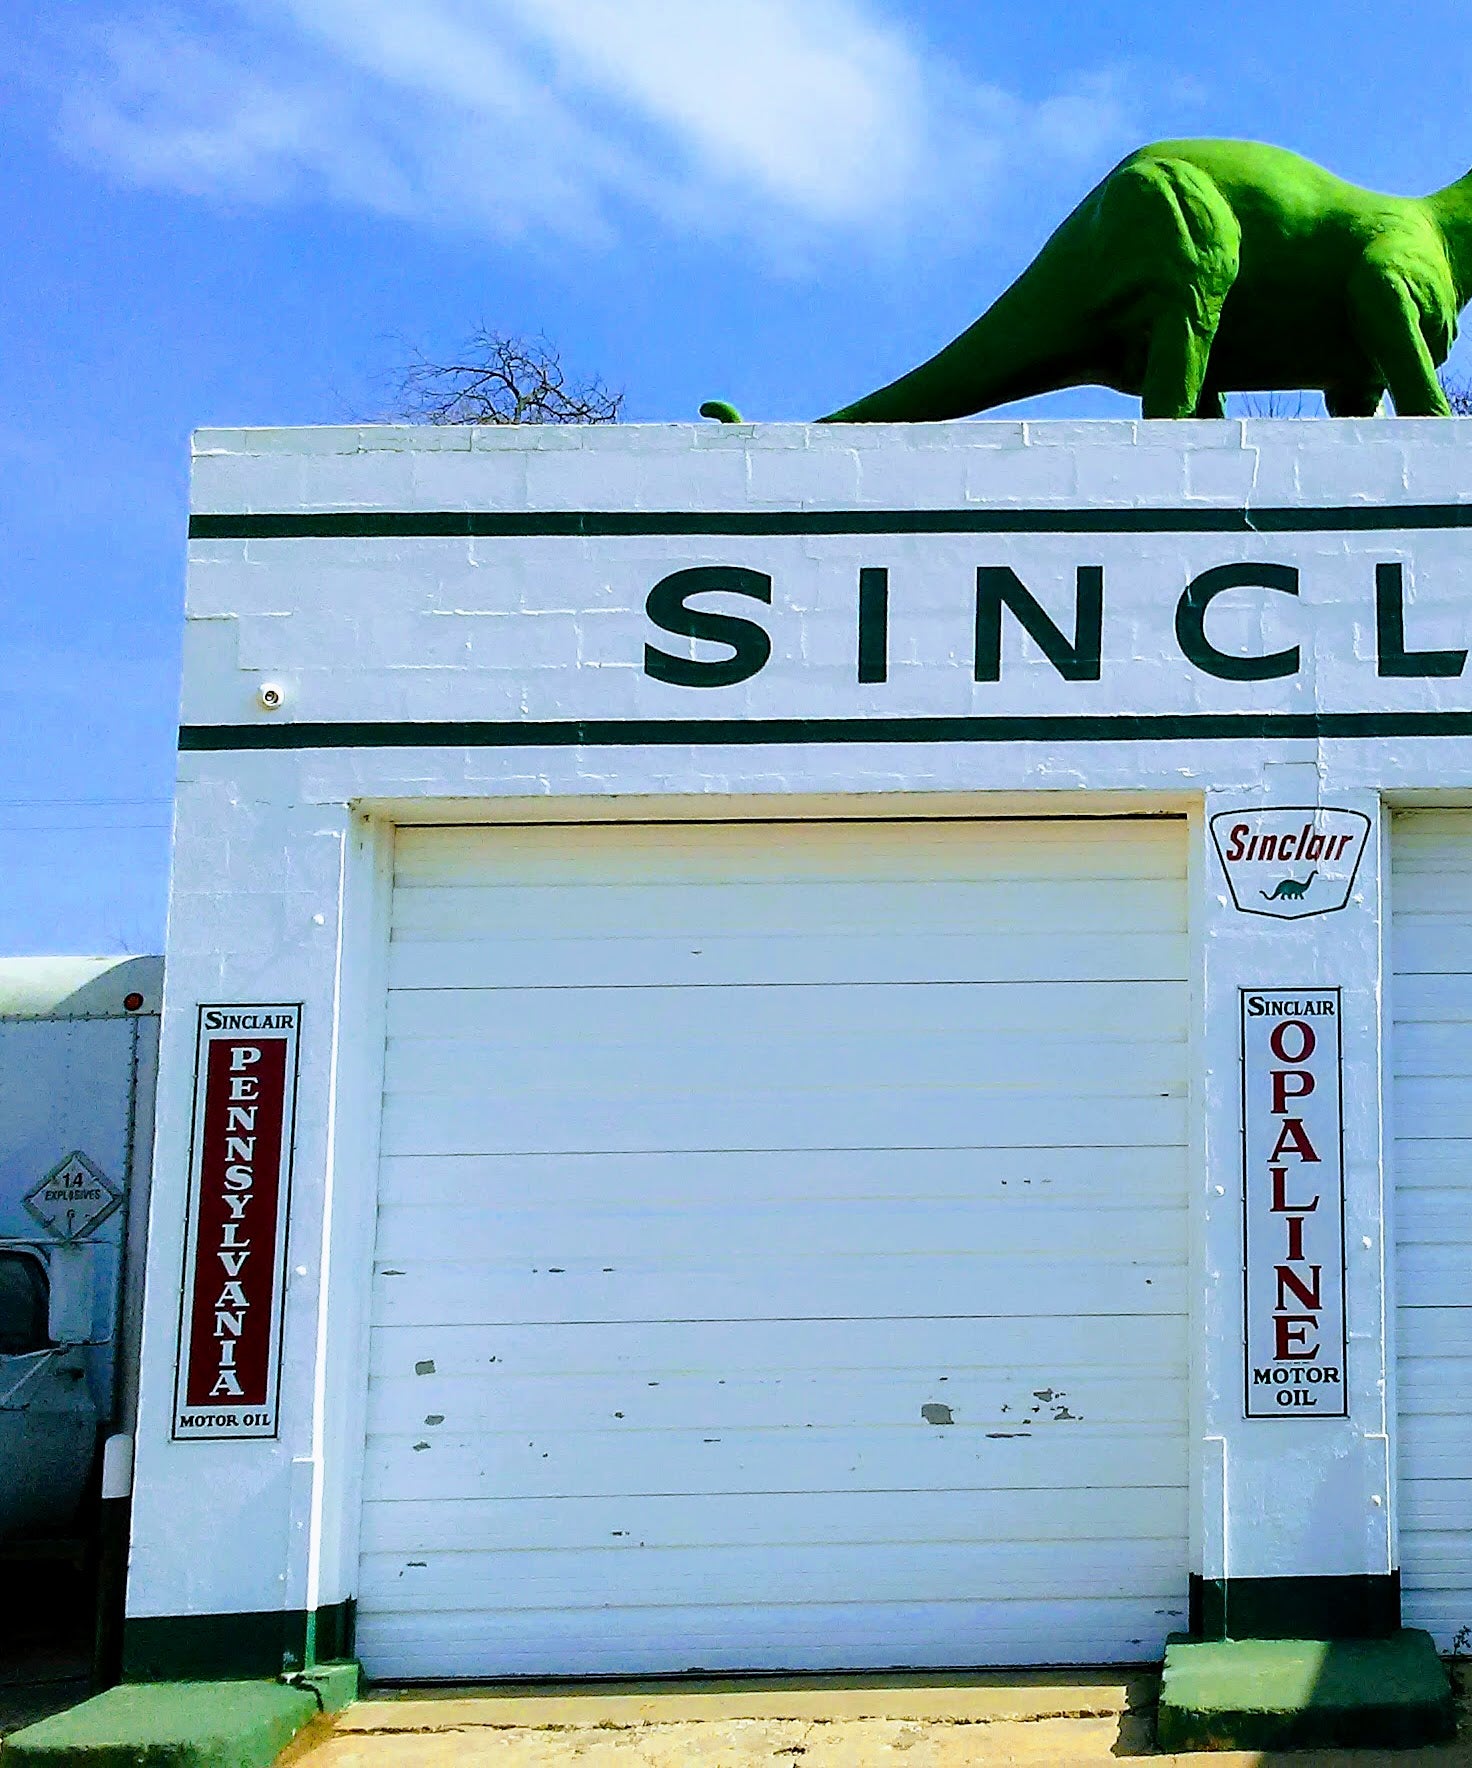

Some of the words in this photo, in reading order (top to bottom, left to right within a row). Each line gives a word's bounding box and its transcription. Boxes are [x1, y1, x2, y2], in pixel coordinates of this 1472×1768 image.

[1226, 823, 1354, 862] Sinclair
[1247, 995, 1335, 1018] SINCLAIR
[204, 1010, 294, 1031] SINCLAIR
[1270, 1019, 1322, 1361] OPALINE
[208, 1046, 262, 1397] PENNSYLVANIA
[1253, 1366, 1341, 1385] MOTOR
[1276, 1389, 1318, 1407] OIL
[179, 1414, 240, 1428] MOTOR
[242, 1413, 272, 1427] OIL
